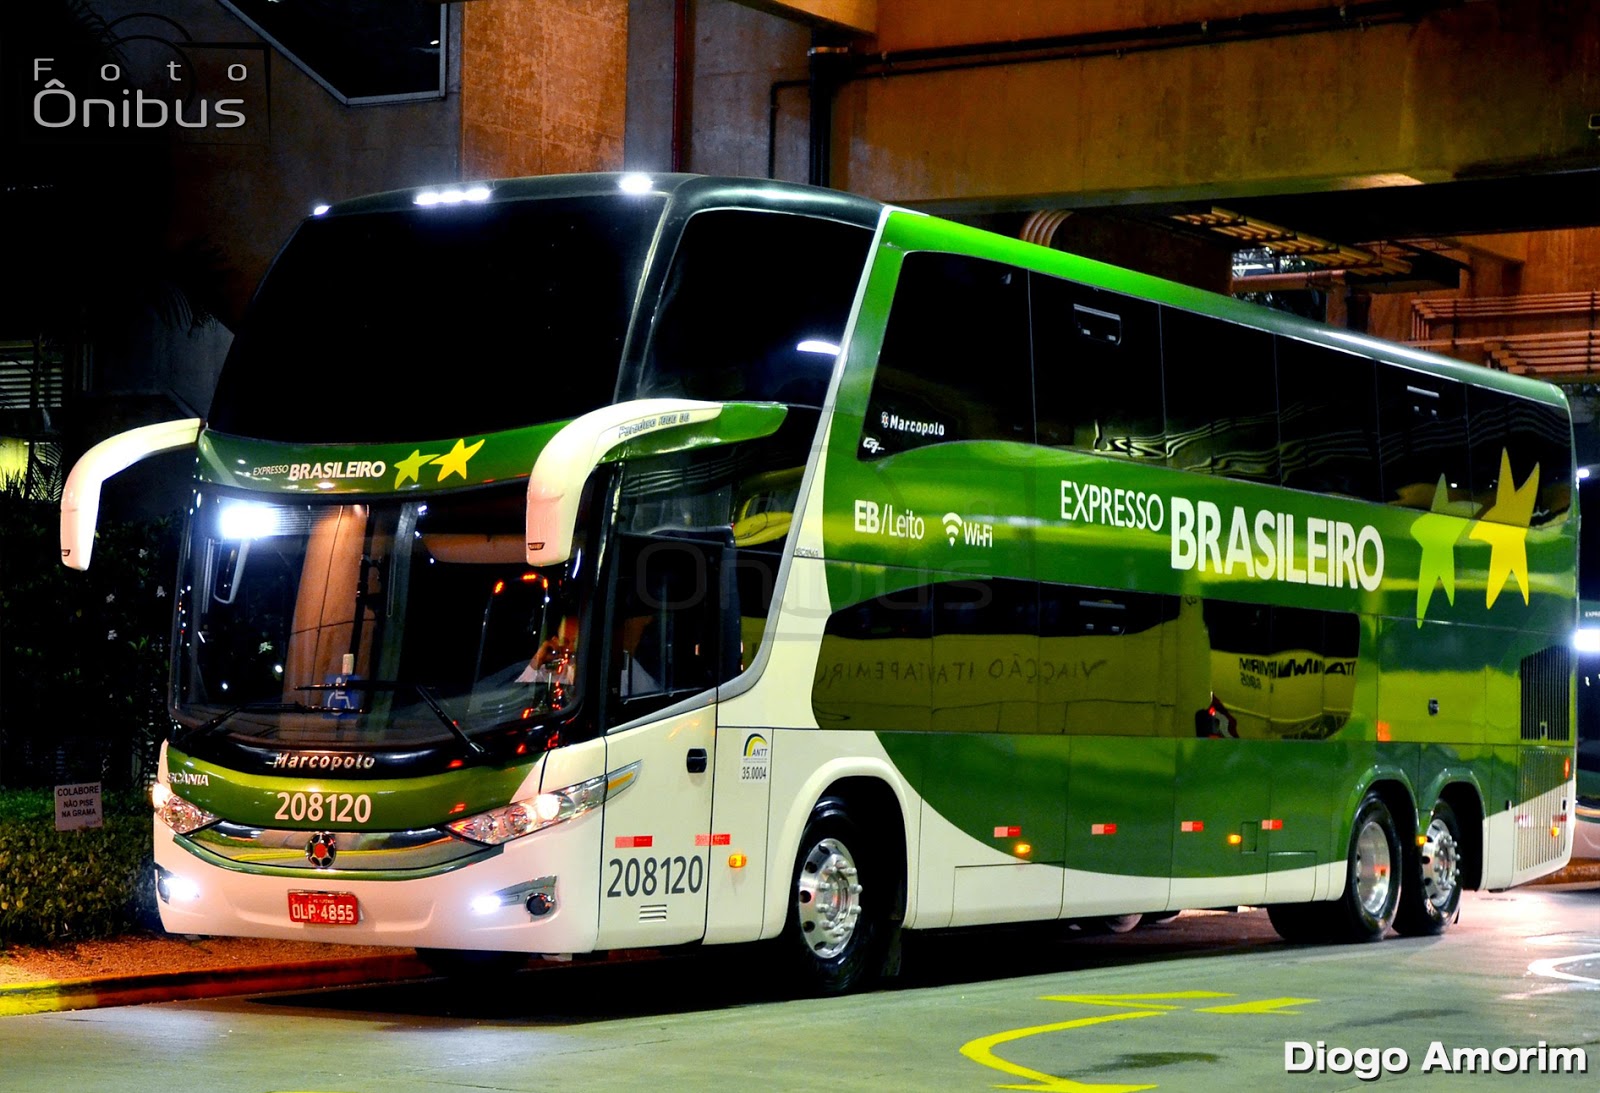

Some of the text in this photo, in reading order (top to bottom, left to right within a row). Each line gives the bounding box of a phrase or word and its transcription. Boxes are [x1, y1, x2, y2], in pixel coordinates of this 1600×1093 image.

[889, 414, 945, 436] Marcopolo
[252, 460, 386, 481] EXPRESSO BRASILEIRO
[963, 521, 993, 548] Wi-Fi
[1060, 479, 1164, 532] EXPRESSO
[1170, 496, 1385, 592] BRASILEIRO
[272, 753, 375, 771] Marcopolo
[752, 749, 768, 757] ANTT
[167, 771, 209, 787] SCANIA
[742, 766, 767, 780] 35.0004
[57, 785, 99, 797] COLABORE
[63, 799, 78, 808] NÃO
[72, 808, 96, 817] GRAMA
[274, 791, 372, 823] 208120
[607, 855, 703, 898] 208120
